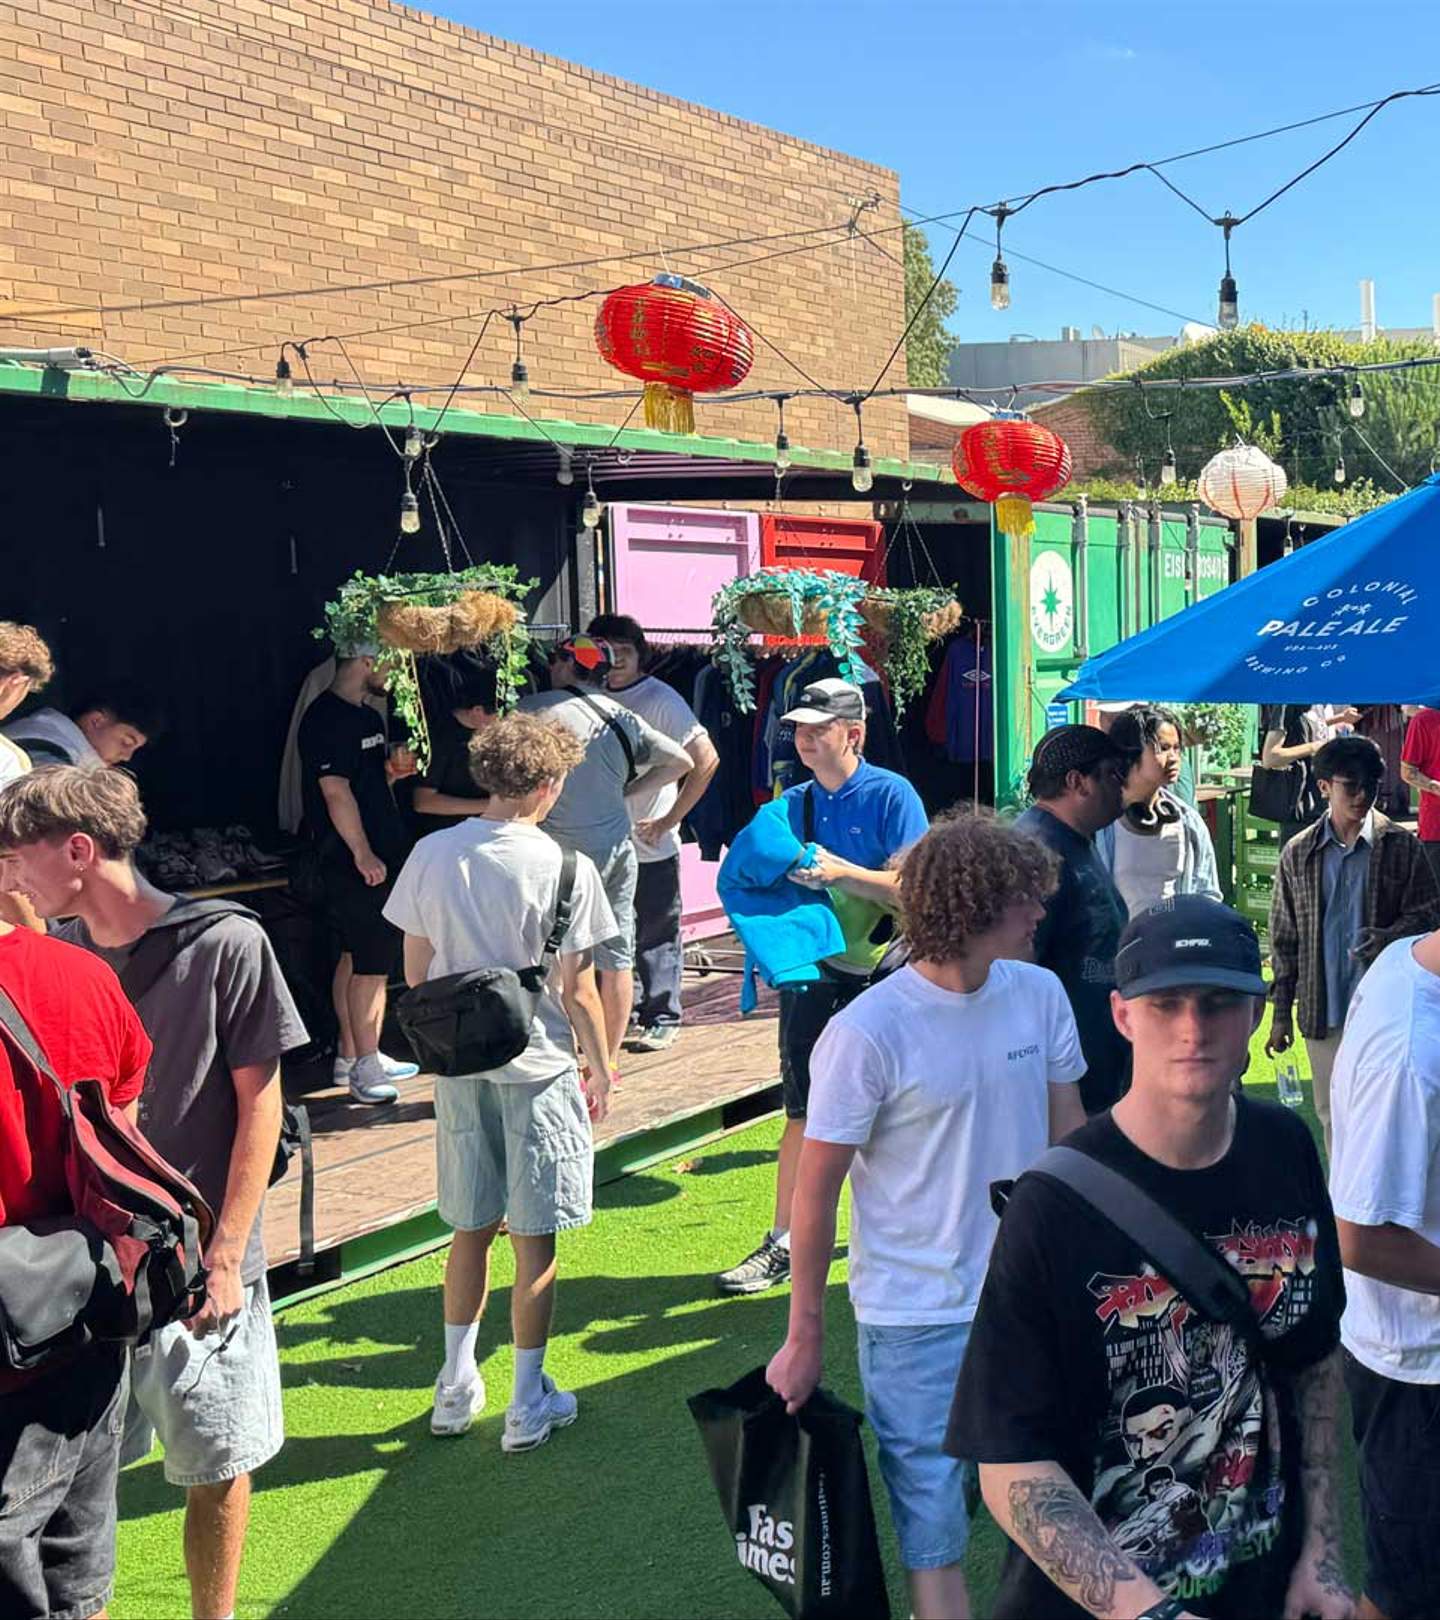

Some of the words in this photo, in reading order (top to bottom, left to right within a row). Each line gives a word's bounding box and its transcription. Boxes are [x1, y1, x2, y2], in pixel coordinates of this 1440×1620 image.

[1302, 580, 1419, 606] COLONIAL
[1256, 619, 1342, 637] PALE
[1338, 616, 1409, 636] ALE
[747, 1503, 795, 1550] Fas
